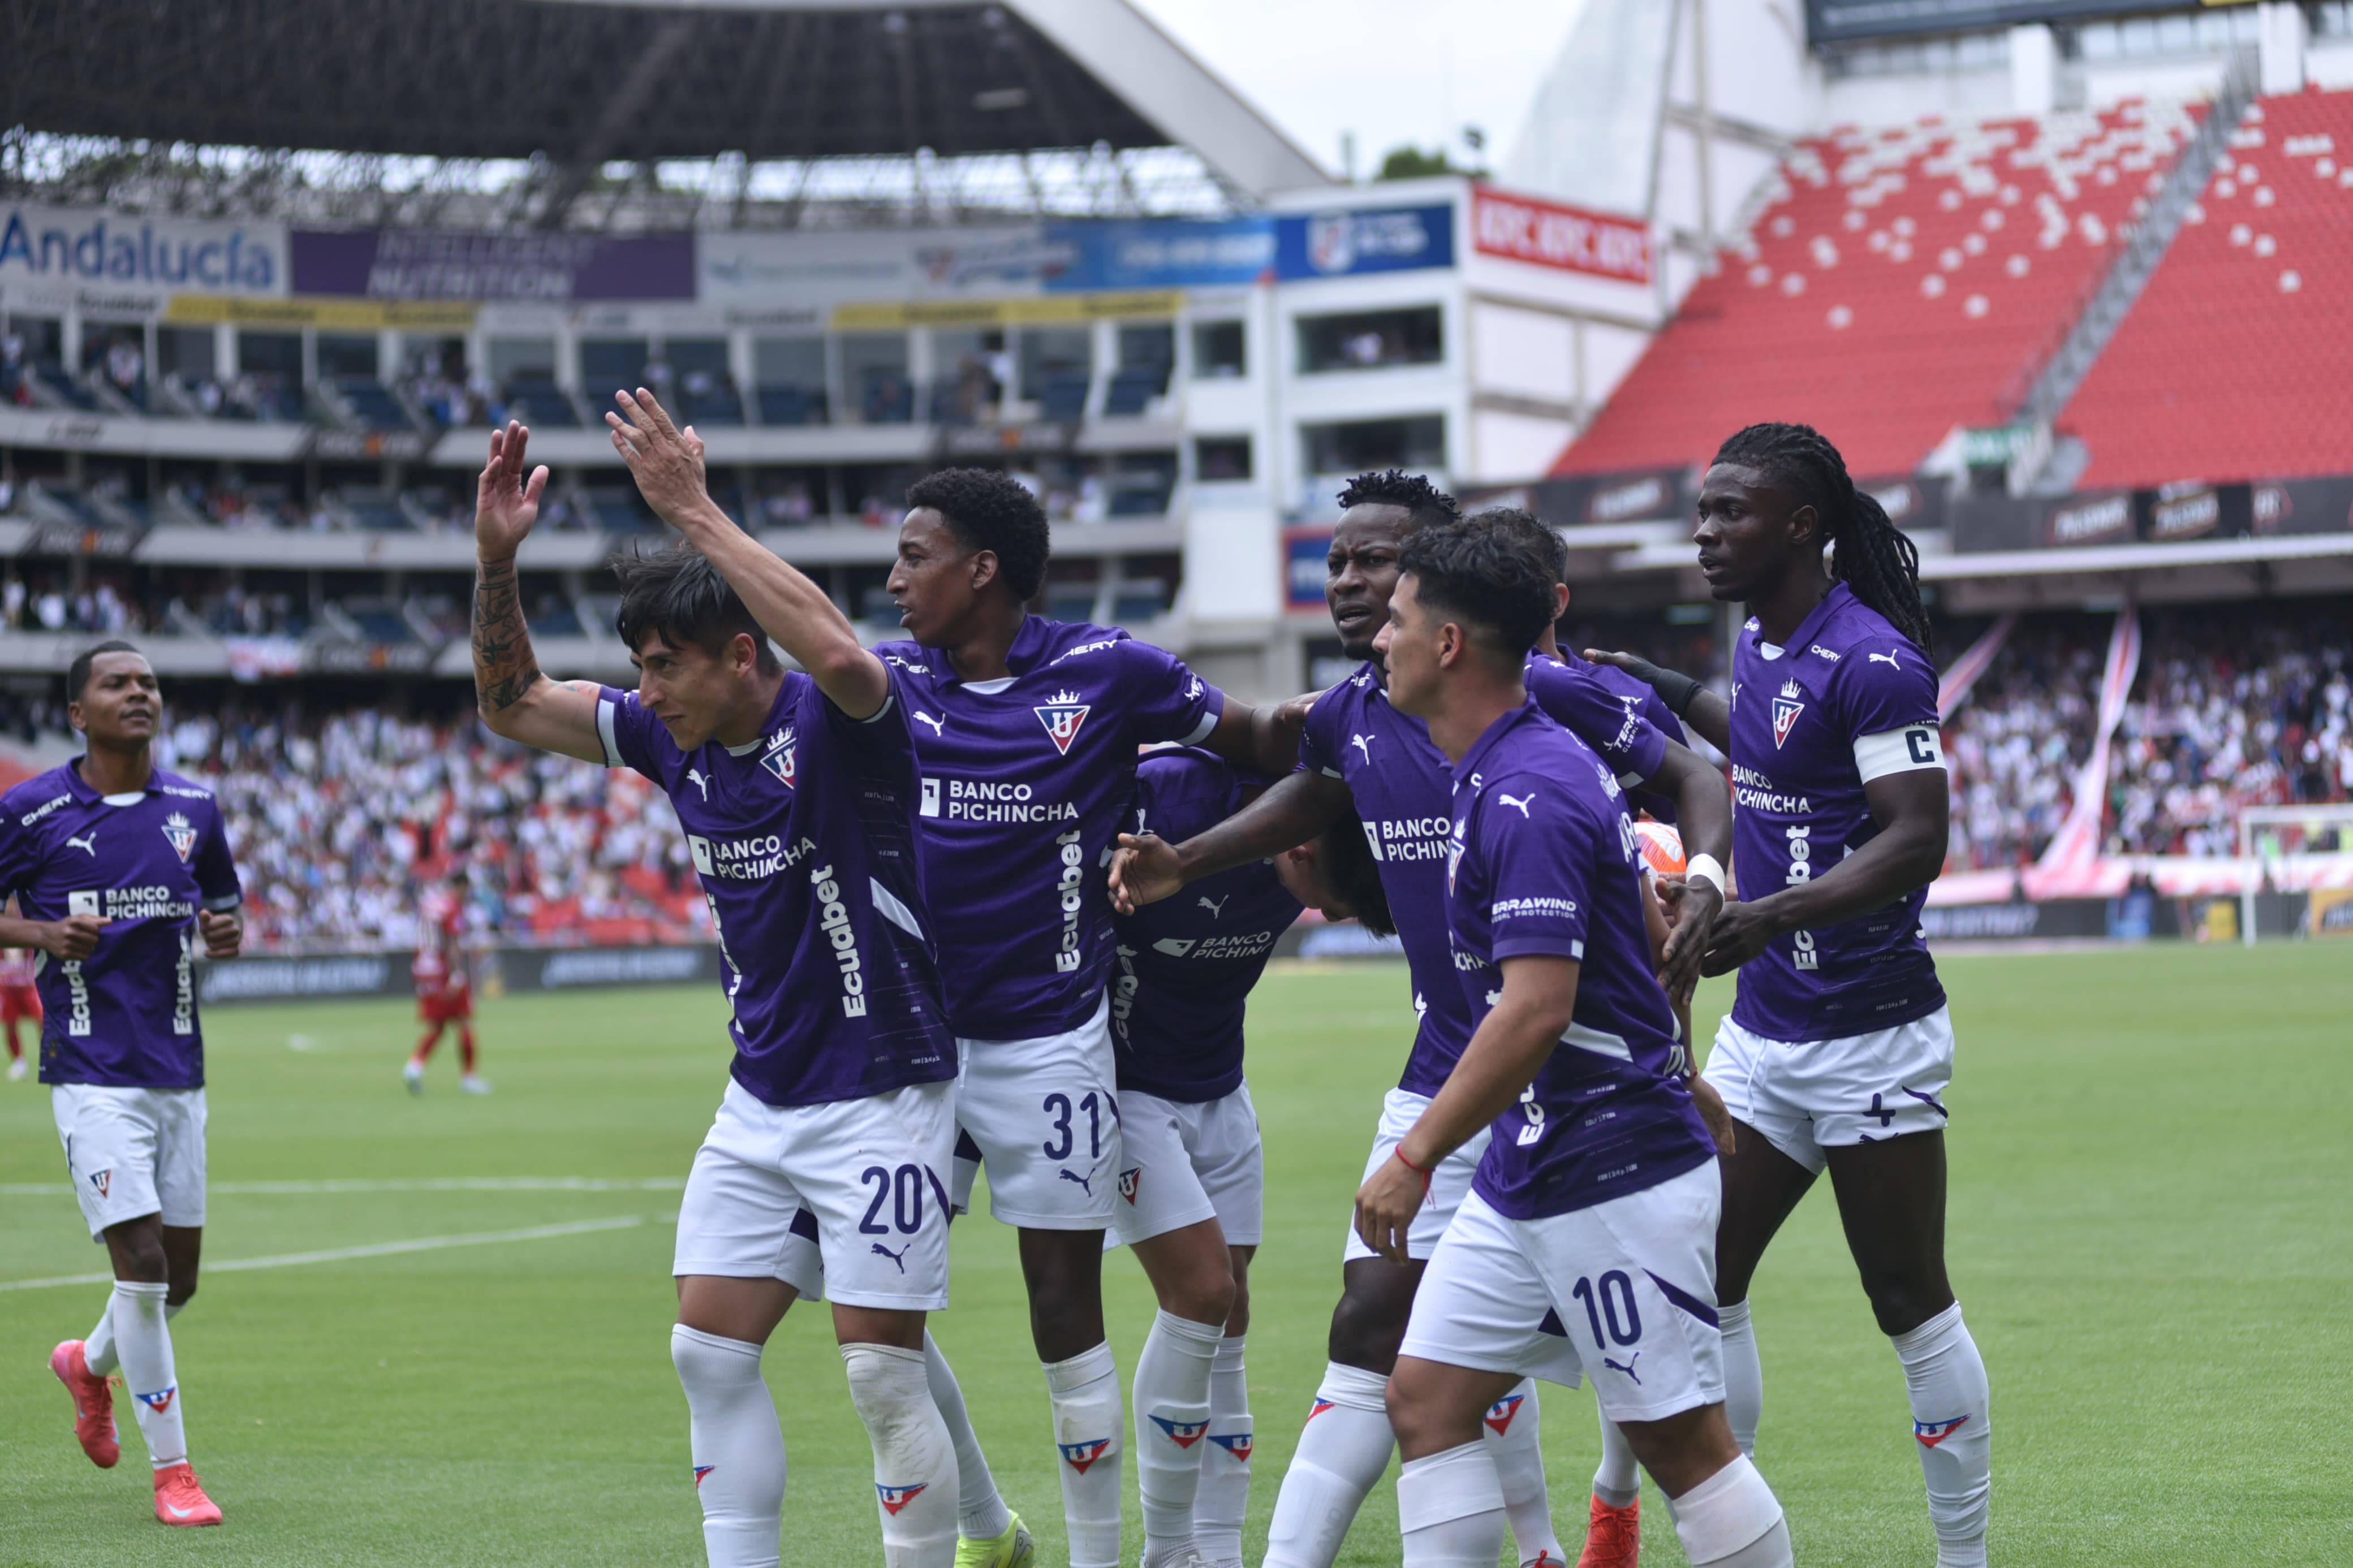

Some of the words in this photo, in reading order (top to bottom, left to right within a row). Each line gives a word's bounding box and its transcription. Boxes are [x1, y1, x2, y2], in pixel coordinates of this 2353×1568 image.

[1811, 644, 1841, 663] CHERY
[1904, 729, 1936, 764] C
[1732, 764, 1773, 791] BANCO
[162, 785, 212, 801] CHERY
[949, 780, 1032, 801] BANCO
[21, 792, 72, 827] CHERY
[948, 801, 1079, 823] PICHINCHA
[1381, 817, 1450, 839] BANCO
[712, 835, 781, 861] BANCO
[717, 836, 816, 880] PICHINCHA
[1386, 839, 1450, 862] PICHIN
[106, 885, 170, 904] BANCO
[1055, 830, 1084, 973] Ecuabet
[1492, 897, 1577, 915] ERRAWIND
[106, 901, 193, 919] PICHINCHA
[1514, 908, 1575, 920] PROTECTION
[810, 864, 867, 1018] Ecuabet
[1200, 931, 1272, 948] BANCO
[1863, 1092, 1897, 1128] 4
[1042, 1092, 1099, 1161] 31
[858, 1163, 923, 1235] 20
[1572, 1268, 1643, 1350] 10
